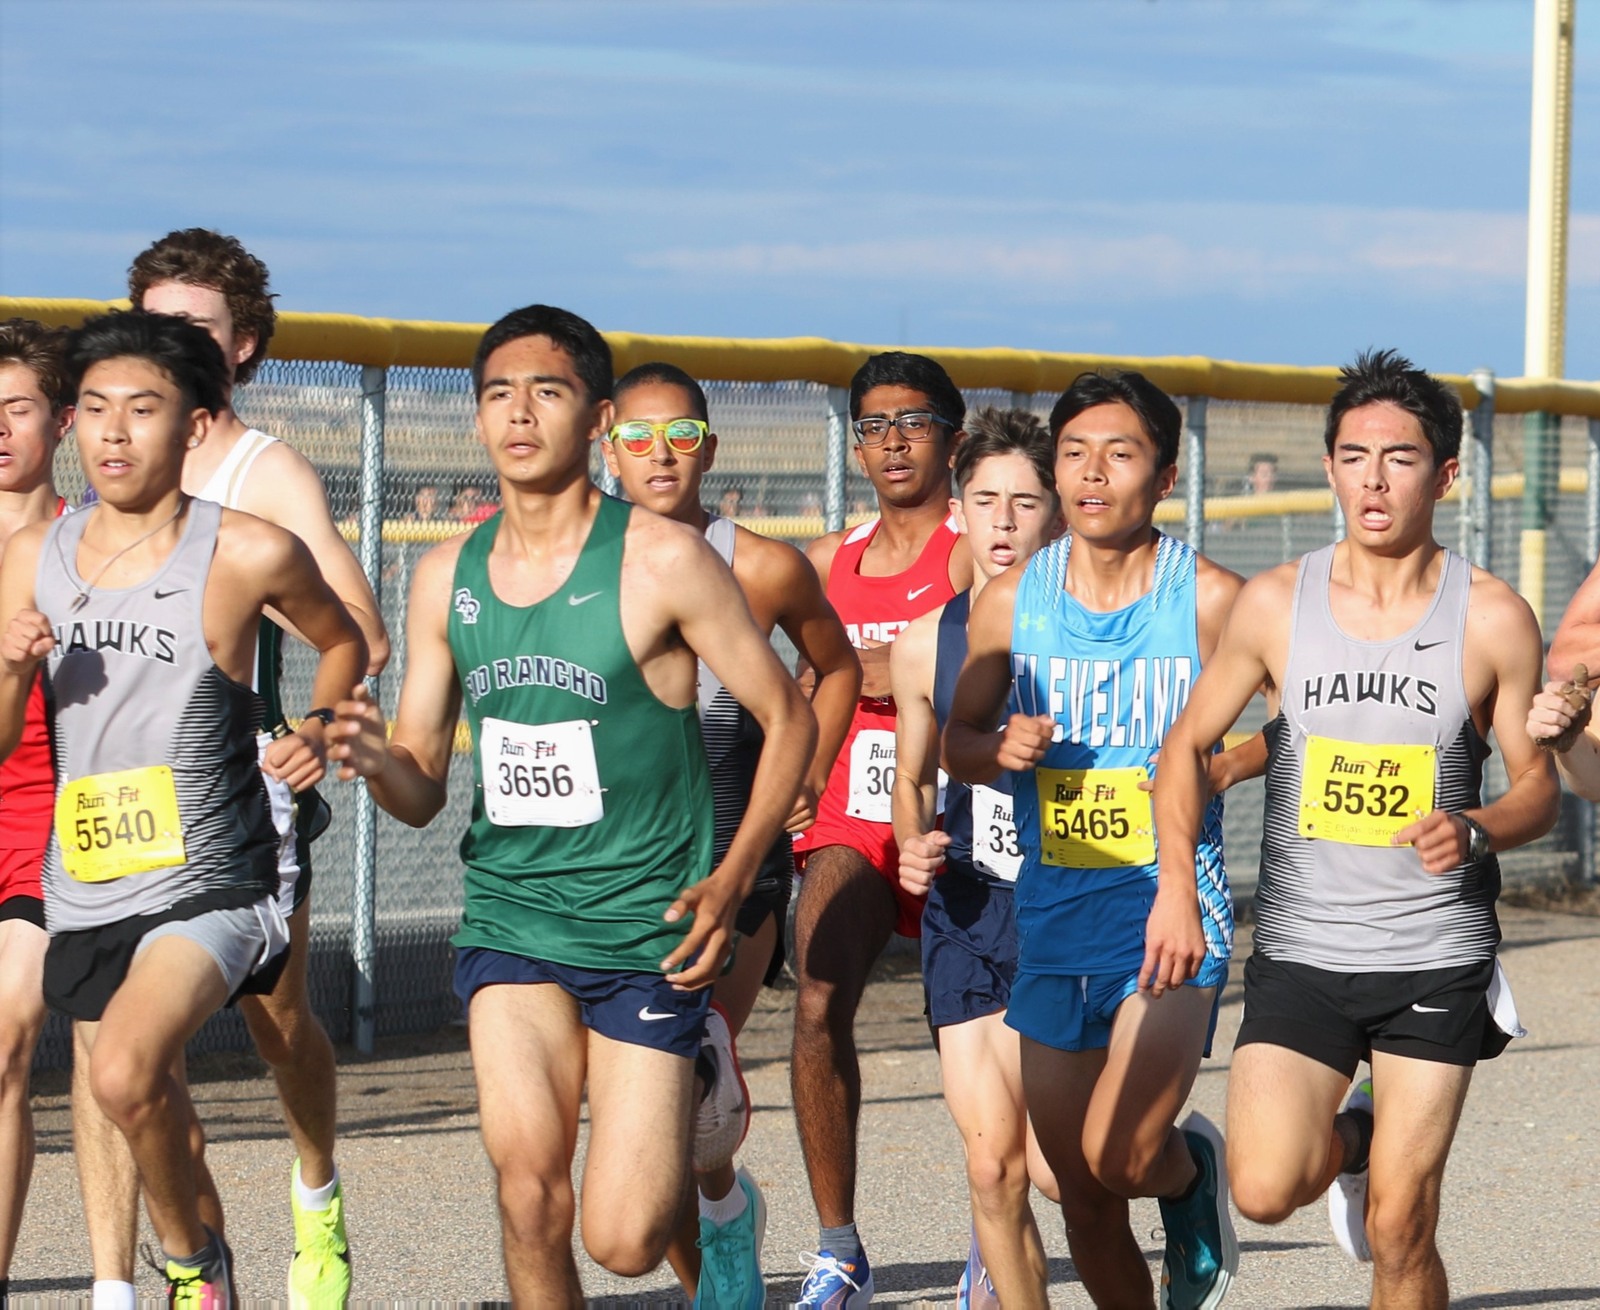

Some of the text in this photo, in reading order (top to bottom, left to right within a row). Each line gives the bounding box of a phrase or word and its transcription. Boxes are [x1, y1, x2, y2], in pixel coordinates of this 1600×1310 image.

[492, 655, 608, 705] RANCHO
[1300, 669, 1440, 718] HAWKS
[501, 736, 557, 759] Run Fit
[499, 762, 574, 798] 3656
[866, 766, 896, 796] 30
[1330, 755, 1402, 778] Run Fit
[76, 786, 141, 813] Run Fit
[1055, 783, 1116, 802] Run Fit
[1323, 779, 1410, 818] 5532
[992, 804, 1014, 822] Ru
[1054, 807, 1130, 840] 5465
[75, 809, 156, 852] 5540
[989, 825, 1021, 857] 33
